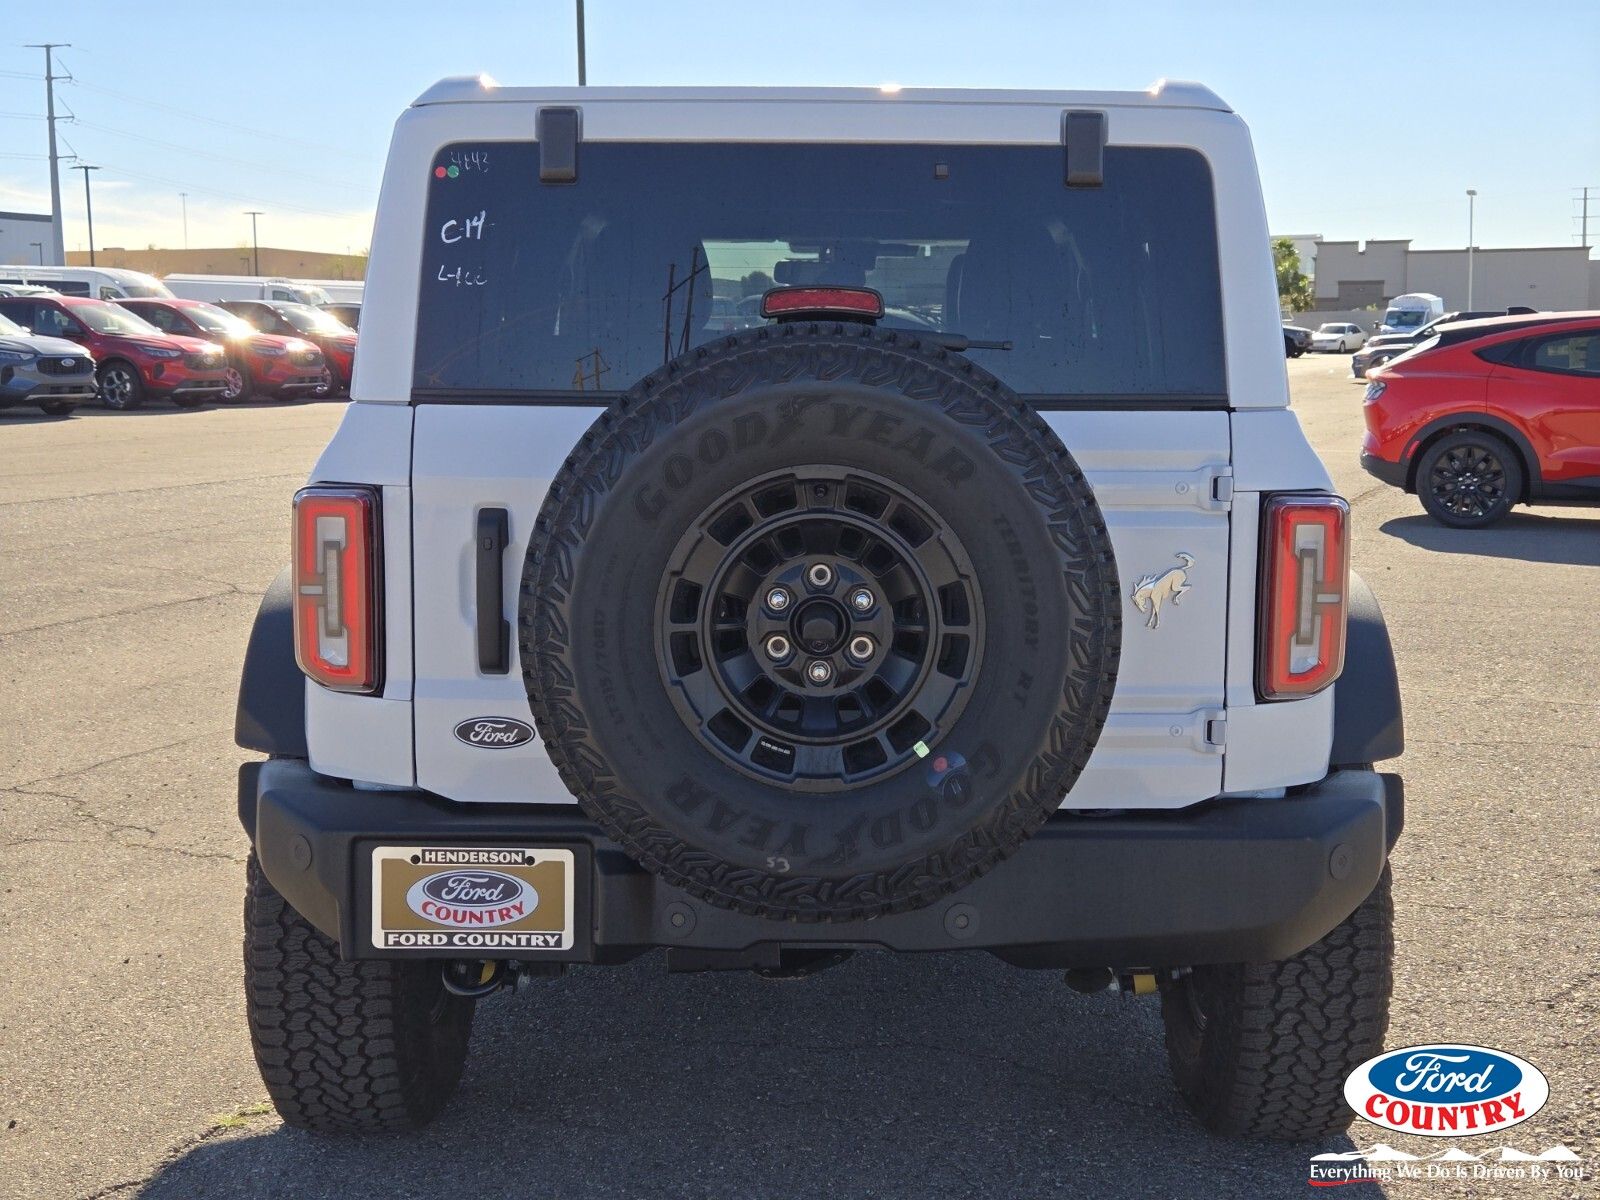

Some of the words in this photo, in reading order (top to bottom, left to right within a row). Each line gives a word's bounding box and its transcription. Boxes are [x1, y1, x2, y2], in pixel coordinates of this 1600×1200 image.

[470, 722, 518, 743] Ford
[424, 851, 523, 864] HENDERSON
[441, 876, 504, 901] Ford
[421, 900, 525, 924] COUNTRY
[387, 933, 448, 946] FORD
[452, 934, 560, 947] COUNTRY
